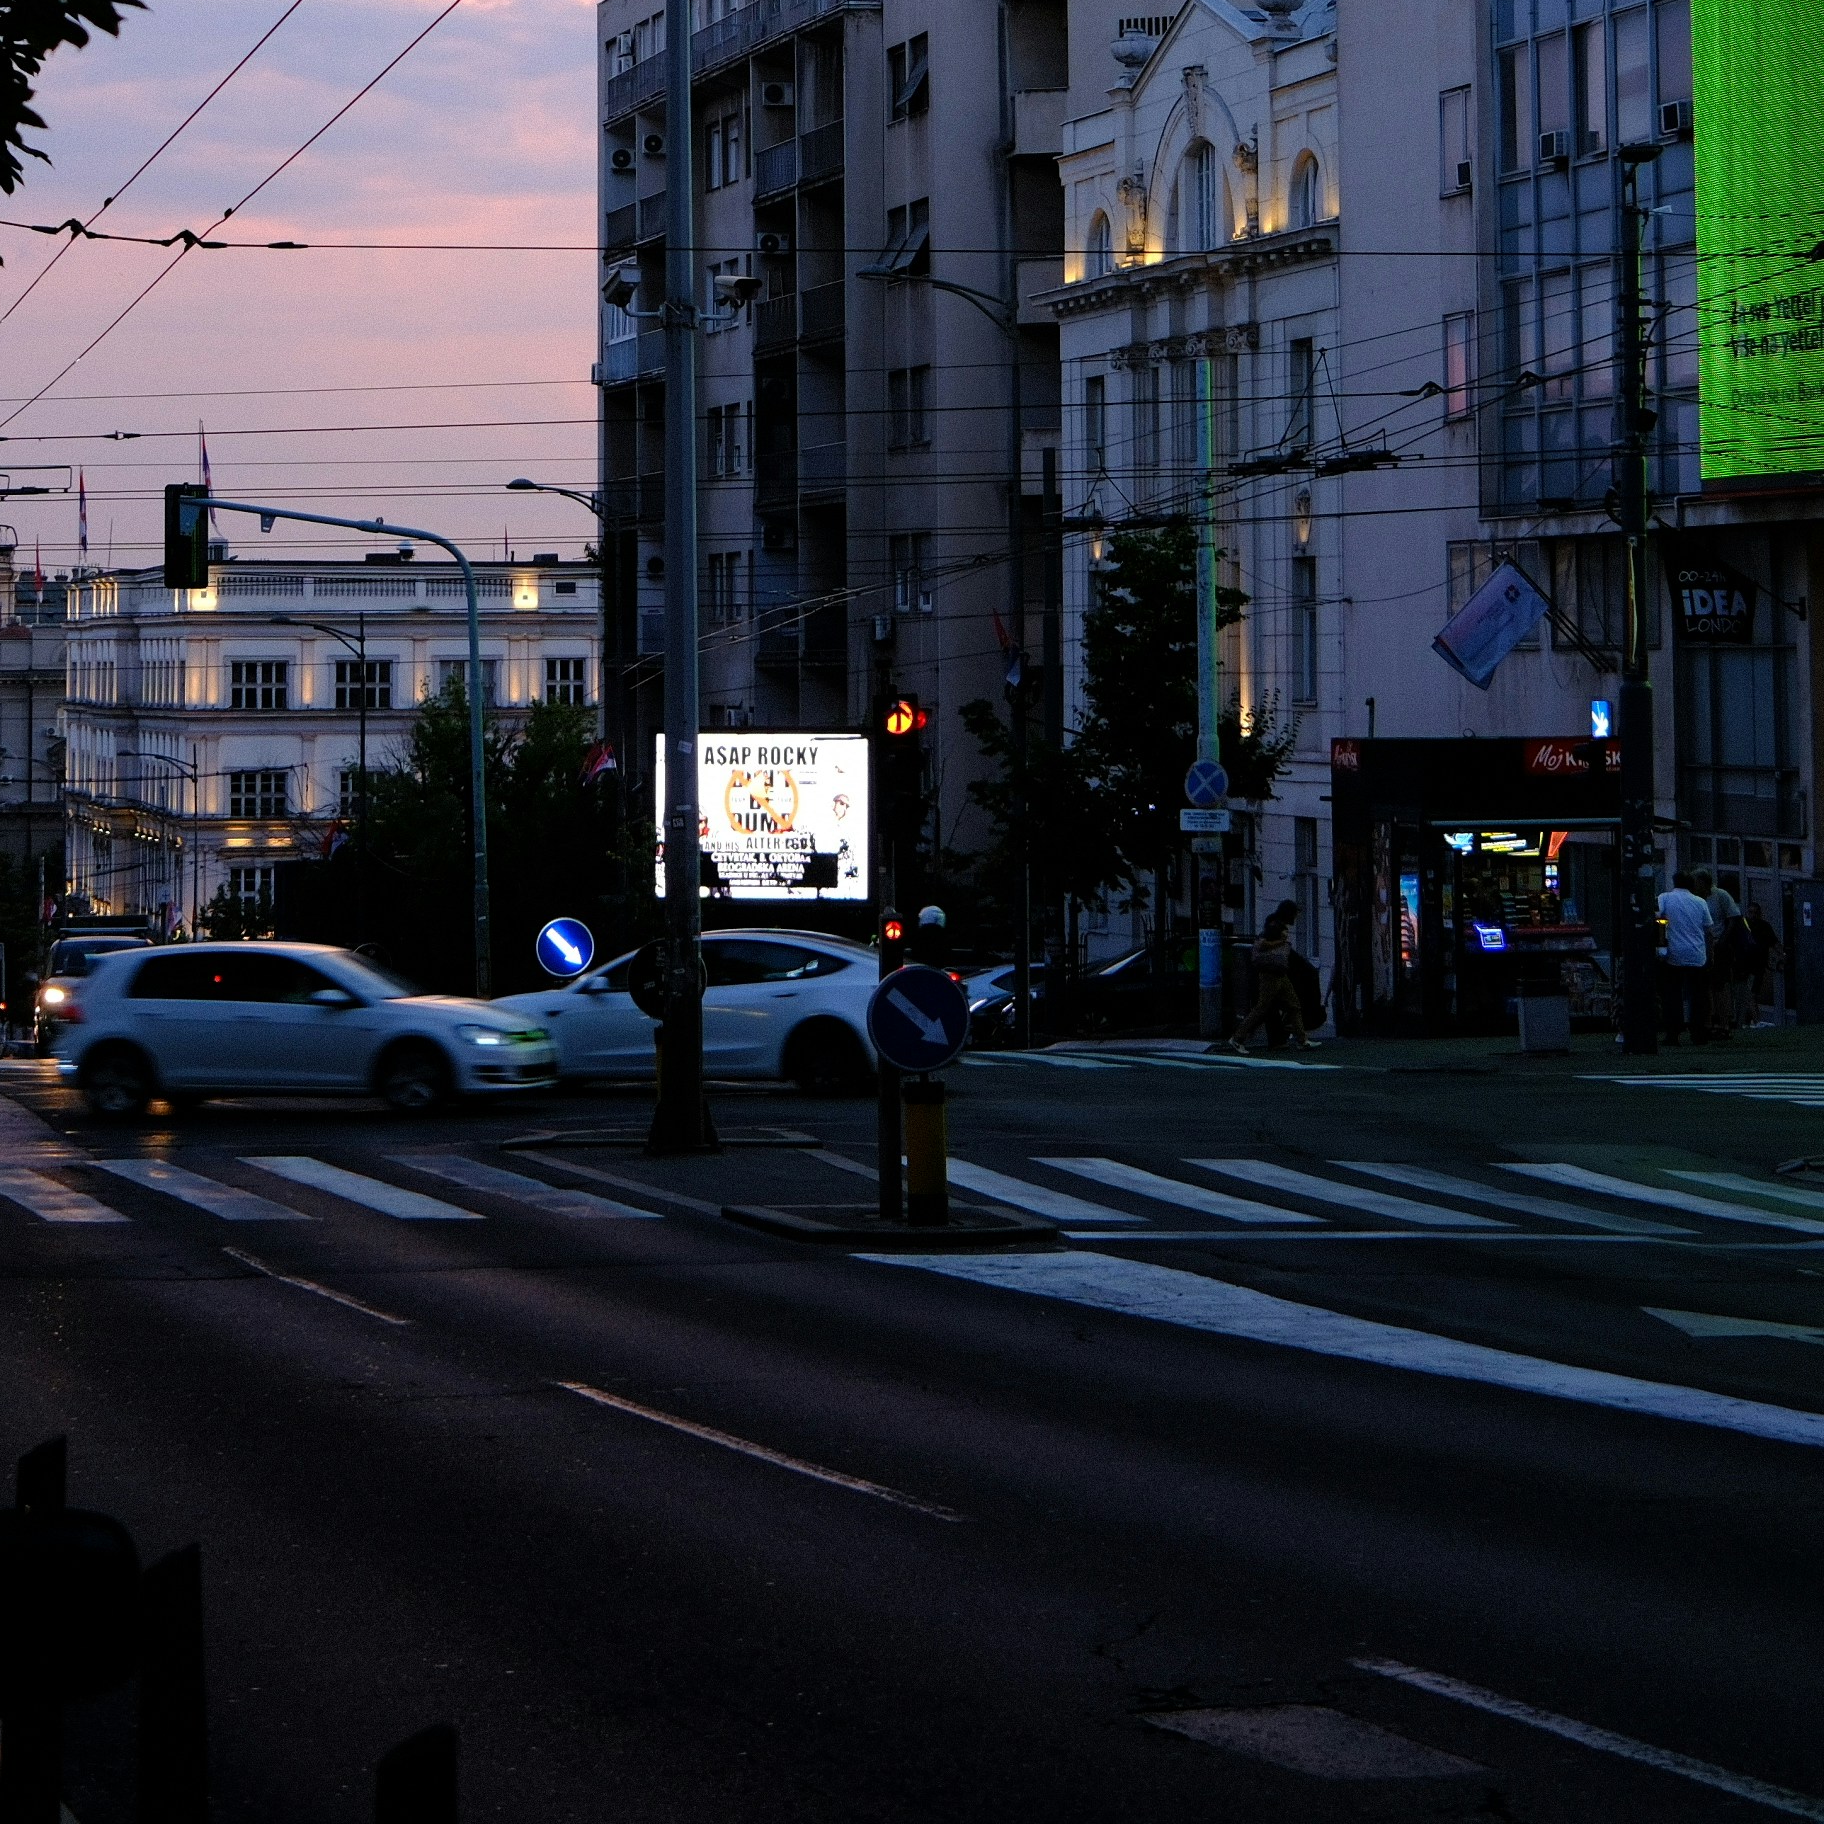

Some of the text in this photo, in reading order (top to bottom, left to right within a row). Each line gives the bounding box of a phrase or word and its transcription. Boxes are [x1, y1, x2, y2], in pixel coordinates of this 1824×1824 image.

[758, 746, 819, 765] ROCKY
[1531, 743, 1621, 772] Moj KSK
